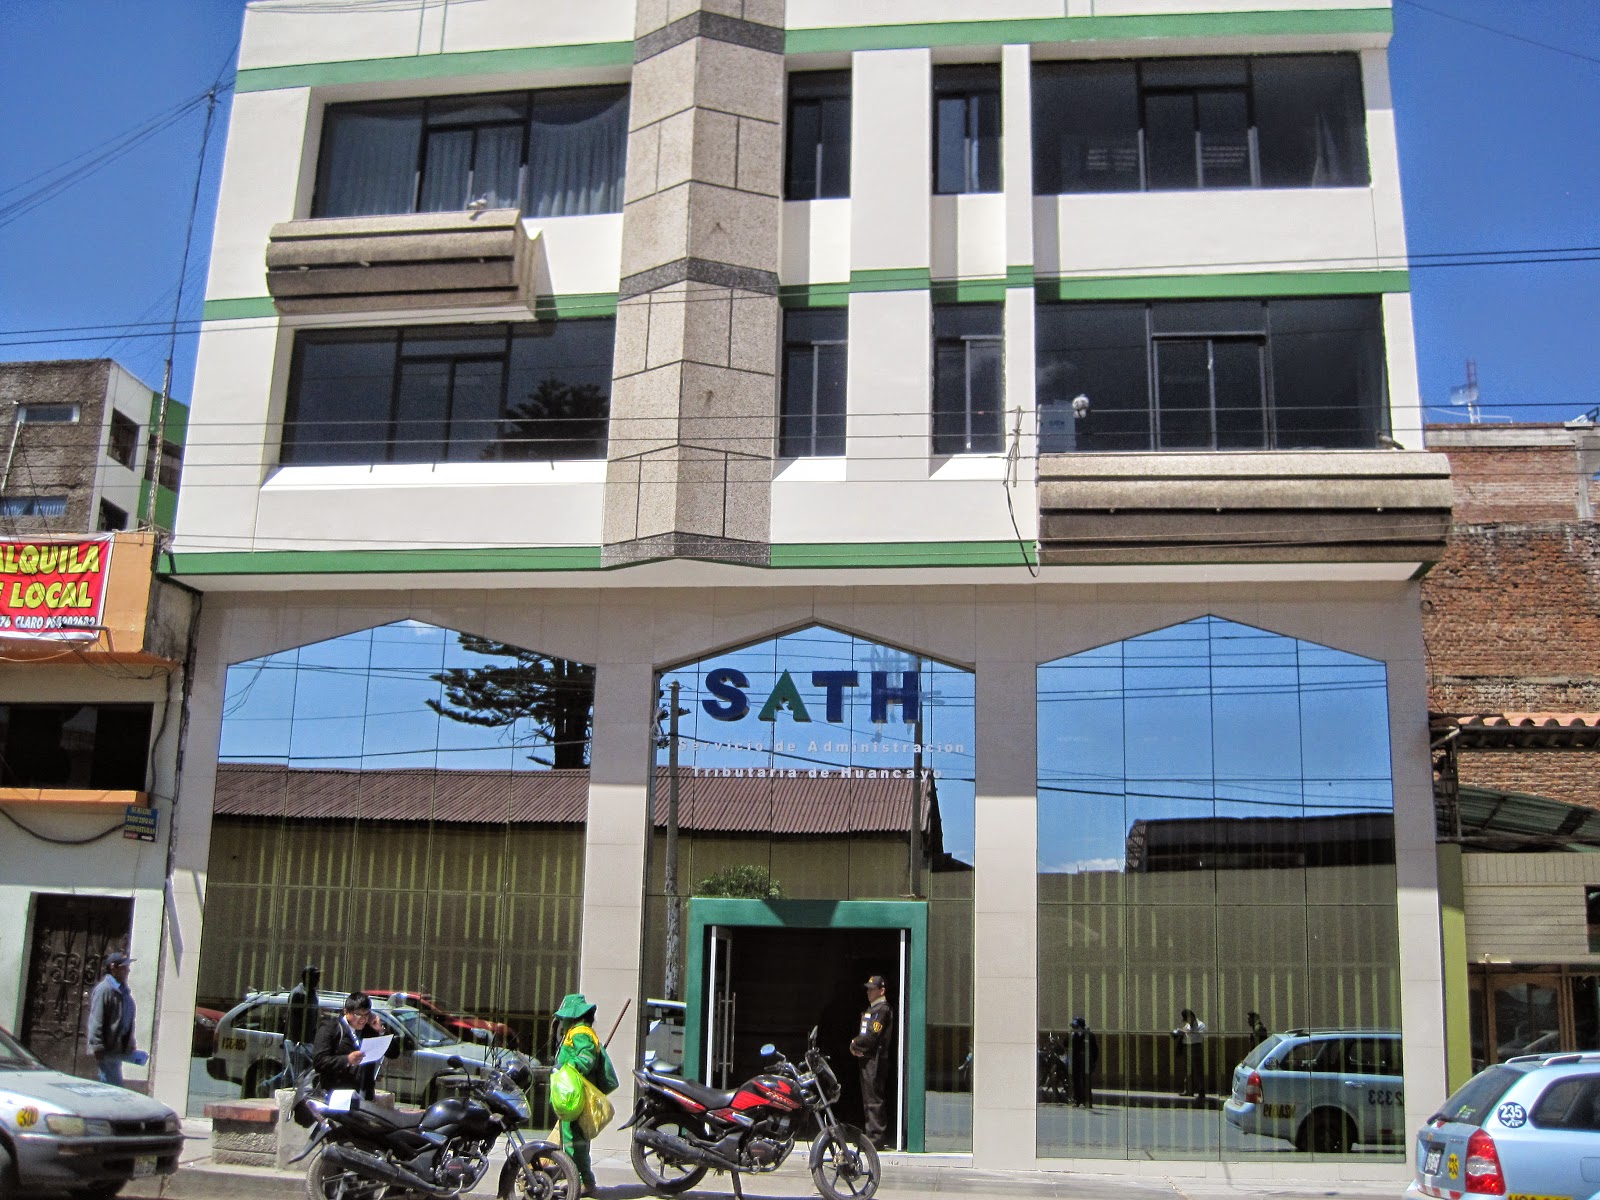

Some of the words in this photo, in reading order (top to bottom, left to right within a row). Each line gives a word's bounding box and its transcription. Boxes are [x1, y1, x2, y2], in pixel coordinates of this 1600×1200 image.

[0, 545, 100, 574] LQUILA
[9, 582, 92, 608] LOCAL
[15, 615, 44, 629] CLARO
[702, 667, 919, 724] SATH
[678, 741, 764, 752] Servicio
[775, 741, 796, 752] de
[692, 766, 797, 778] Tributaria
[808, 767, 830, 779] de
[841, 767, 942, 782] Huancayo
[1500, 1105, 1523, 1119] 235
